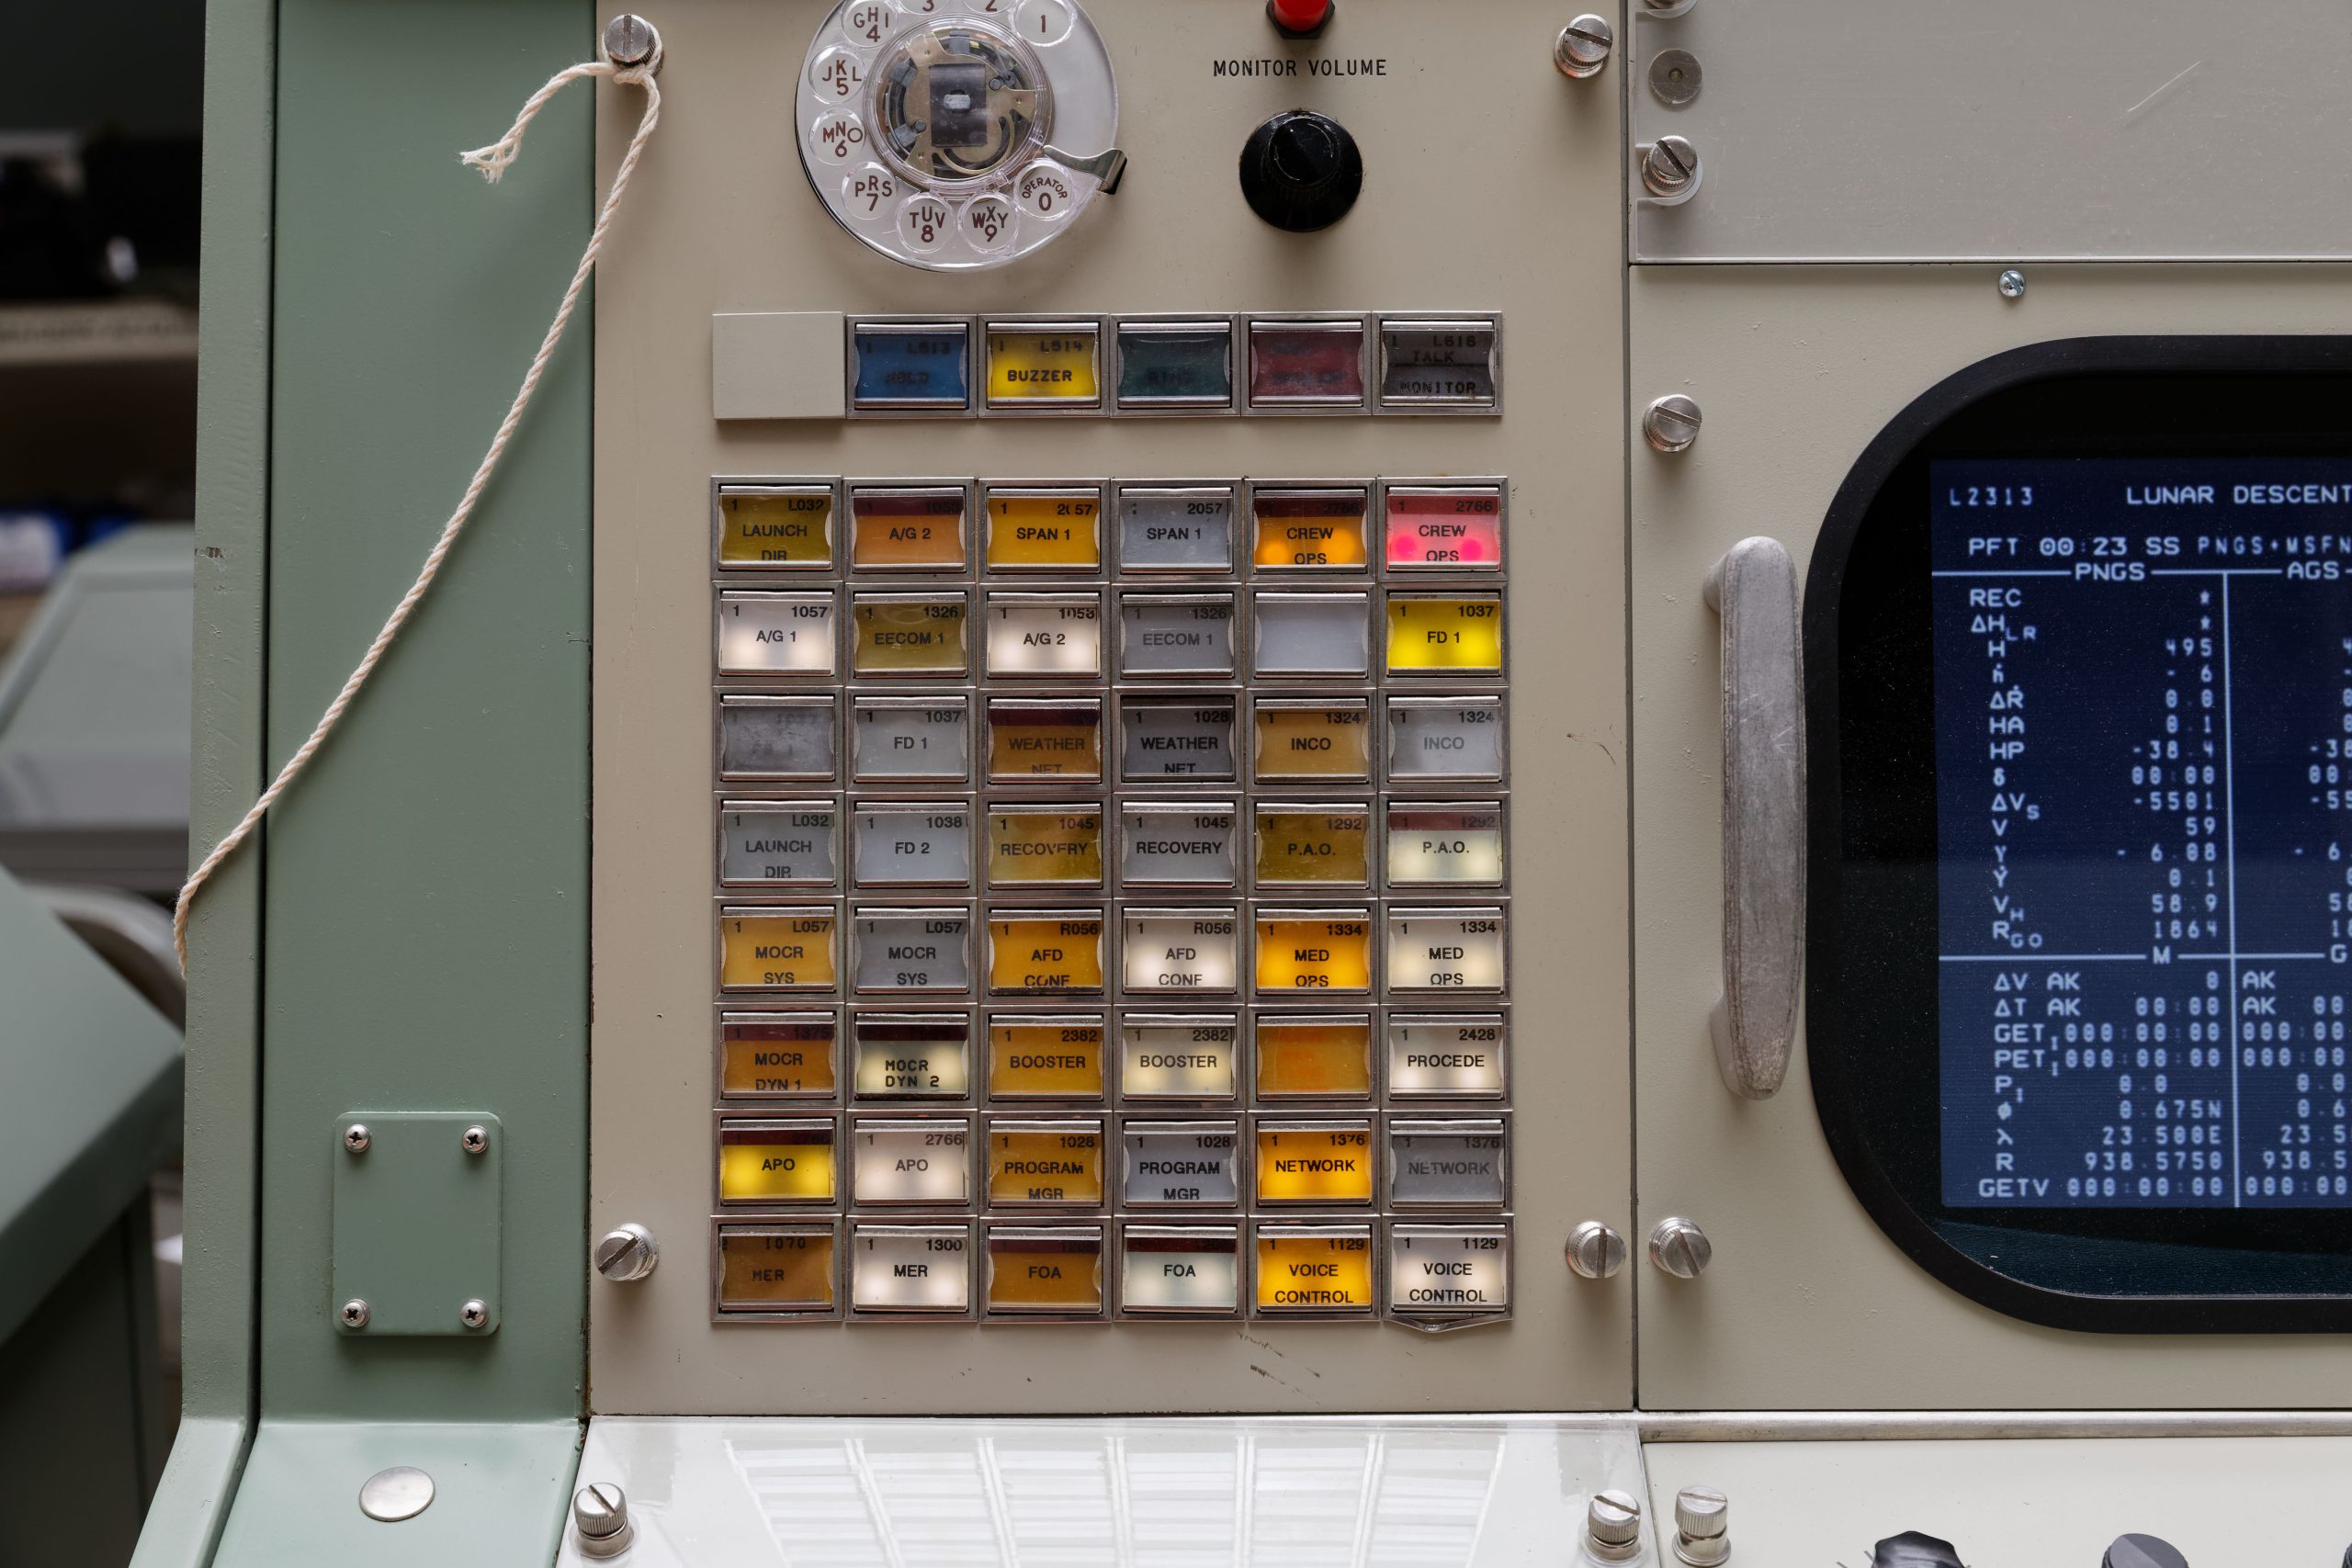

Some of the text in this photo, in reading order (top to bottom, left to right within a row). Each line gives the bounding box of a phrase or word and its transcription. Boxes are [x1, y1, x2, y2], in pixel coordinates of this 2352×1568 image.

[854, 7, 889, 28] GHI
[1041, 16, 1046, 32] 1
[866, 26, 880, 42] 4
[1214, 59, 1386, 76] MONITOR VOLUME
[837, 79, 848, 96] 5
[835, 141, 847, 157] 6
[1022, 177, 1068, 199] OPERATOR
[866, 194, 878, 211] 7
[922, 226, 933, 242] 8
[985, 225, 997, 242] 9
[1413, 351, 1453, 363] TALK
[1007, 369, 1072, 382] BUZZER
[1399, 381, 1476, 394] MONITOR
[1950, 488, 2033, 505] L2313
[2127, 486, 2214, 504] LUNAR
[1187, 502, 1222, 514] 2057
[1456, 501, 1492, 513] 2766
[742, 525, 808, 537] LAUNCH
[889, 527, 931, 540] A/G 2
[1016, 527, 1070, 541] SPAN 1
[1147, 527, 1201, 540] SPAN 1
[1287, 527, 1334, 540] CREW
[1419, 525, 1466, 537] CREW
[1969, 537, 2018, 556] PFT
[2146, 537, 2179, 555] SS
[762, 550, 787, 561] DIR
[1295, 553, 1327, 565] OPS
[1426, 550, 1459, 562] OPS
[2075, 564, 2145, 581] PNGS
[2287, 561, 2339, 579] AGS
[1970, 589, 2021, 606] REC
[791, 605, 827, 618] 1057
[924, 606, 958, 618] 1326
[1193, 608, 1227, 620] 1326
[1458, 605, 1495, 618] 1037
[756, 630, 797, 643] A/G 1
[875, 632, 944, 645] EECOM 1
[1023, 633, 1066, 646] A/G 2
[1142, 634, 1213, 646] EECOM 1
[1428, 631, 1460, 643] FD 1
[2165, 638, 2211, 657] 495
[925, 711, 961, 723] 1037
[1194, 711, 1229, 723] 1028
[1326, 712, 1361, 724] 1324
[1458, 711, 1495, 723] 1324
[1989, 717, 2024, 733] HA
[894, 737, 927, 749] FD 1
[1010, 738, 1084, 750] WEATHER
[1140, 737, 1218, 750] WEATHER
[1291, 738, 1331, 750] INCO
[1424, 737, 1464, 750] INCO
[1990, 743, 2024, 760] HP
[1165, 763, 1196, 773] NET
[792, 816, 830, 828] L032
[926, 817, 962, 829] 1038
[1058, 818, 1093, 829] 1045
[1193, 817, 1228, 829] 1045
[1326, 818, 1362, 830] 1292
[2186, 818, 2215, 835] 59
[745, 840, 812, 853] LAUNCH
[895, 841, 930, 854] FD 2
[1136, 841, 1222, 854] RECOVERY
[1288, 843, 1336, 856] P.A.O.
[1423, 841, 1470, 853] P.A.O.
[765, 866, 791, 878] DIR
[793, 921, 830, 933] L057
[926, 921, 962, 934] L057
[1060, 923, 1099, 935] R056
[1194, 922, 1231, 934] R056
[1327, 924, 1363, 936] 1334
[1460, 921, 1497, 933] 1334
[2154, 920, 2217, 938] 1864
[755, 946, 803, 959] MOCR
[888, 947, 936, 959] MOCR
[1031, 949, 1063, 962] AFD
[1165, 948, 1196, 960] AFD
[1295, 949, 1329, 962] MED
[1429, 947, 1464, 960] MED
[2153, 947, 2170, 964] M
[2330, 944, 2346, 963] G
[764, 972, 795, 985] SYS
[897, 973, 927, 985] SYS
[1024, 975, 1070, 986] CONF
[1159, 974, 1203, 986] CONF
[1295, 975, 1329, 987] OPS
[1430, 973, 1464, 985] OPS
[2047, 972, 2080, 990] AK
[2243, 971, 2275, 989] AK
[2048, 998, 2080, 1016] AK
[2243, 997, 2276, 1014] AK
[1062, 1030, 1097, 1042] 2382
[1193, 1029, 1229, 1041] 2382
[1459, 1029, 1496, 1041] 2428
[754, 1053, 803, 1066] MOCR
[886, 1060, 928, 1071] MOCR
[1011, 1055, 1085, 1068] BOOSTER
[1140, 1055, 1216, 1068] BOOSTER
[1408, 1055, 1485, 1067] PROCEDE
[756, 1079, 801, 1090] DYN 1
[886, 1076, 939, 1087] DYN 2
[925, 1134, 963, 1145] 2766
[1059, 1136, 1094, 1148] 1028
[1196, 1136, 1230, 1148] 1028
[1464, 1136, 1499, 1148] 1376
[762, 1158, 795, 1171] APO
[896, 1158, 929, 1171] APO
[1004, 1161, 1083, 1174] PROGRAM
[1139, 1161, 1220, 1174] PROGRAM
[1275, 1159, 1355, 1171] NETWORK
[1408, 1162, 1489, 1175] NETWORK
[1028, 1188, 1063, 1200] MGR
[1163, 1188, 1200, 1200] MGR
[1978, 1179, 2049, 1197] GETV
[926, 1239, 962, 1251] 1300
[1329, 1238, 1365, 1250] 1129
[1463, 1237, 1498, 1249] 1129
[751, 1269, 785, 1281] MER
[894, 1265, 928, 1277] MER
[1029, 1267, 1061, 1279] FOA
[1163, 1264, 1196, 1277] FOA
[1289, 1264, 1339, 1277] VOICE
[1423, 1263, 1472, 1276] VOICE
[1275, 1291, 1353, 1303] CONTROL
[1409, 1289, 1487, 1303] CONTROL
